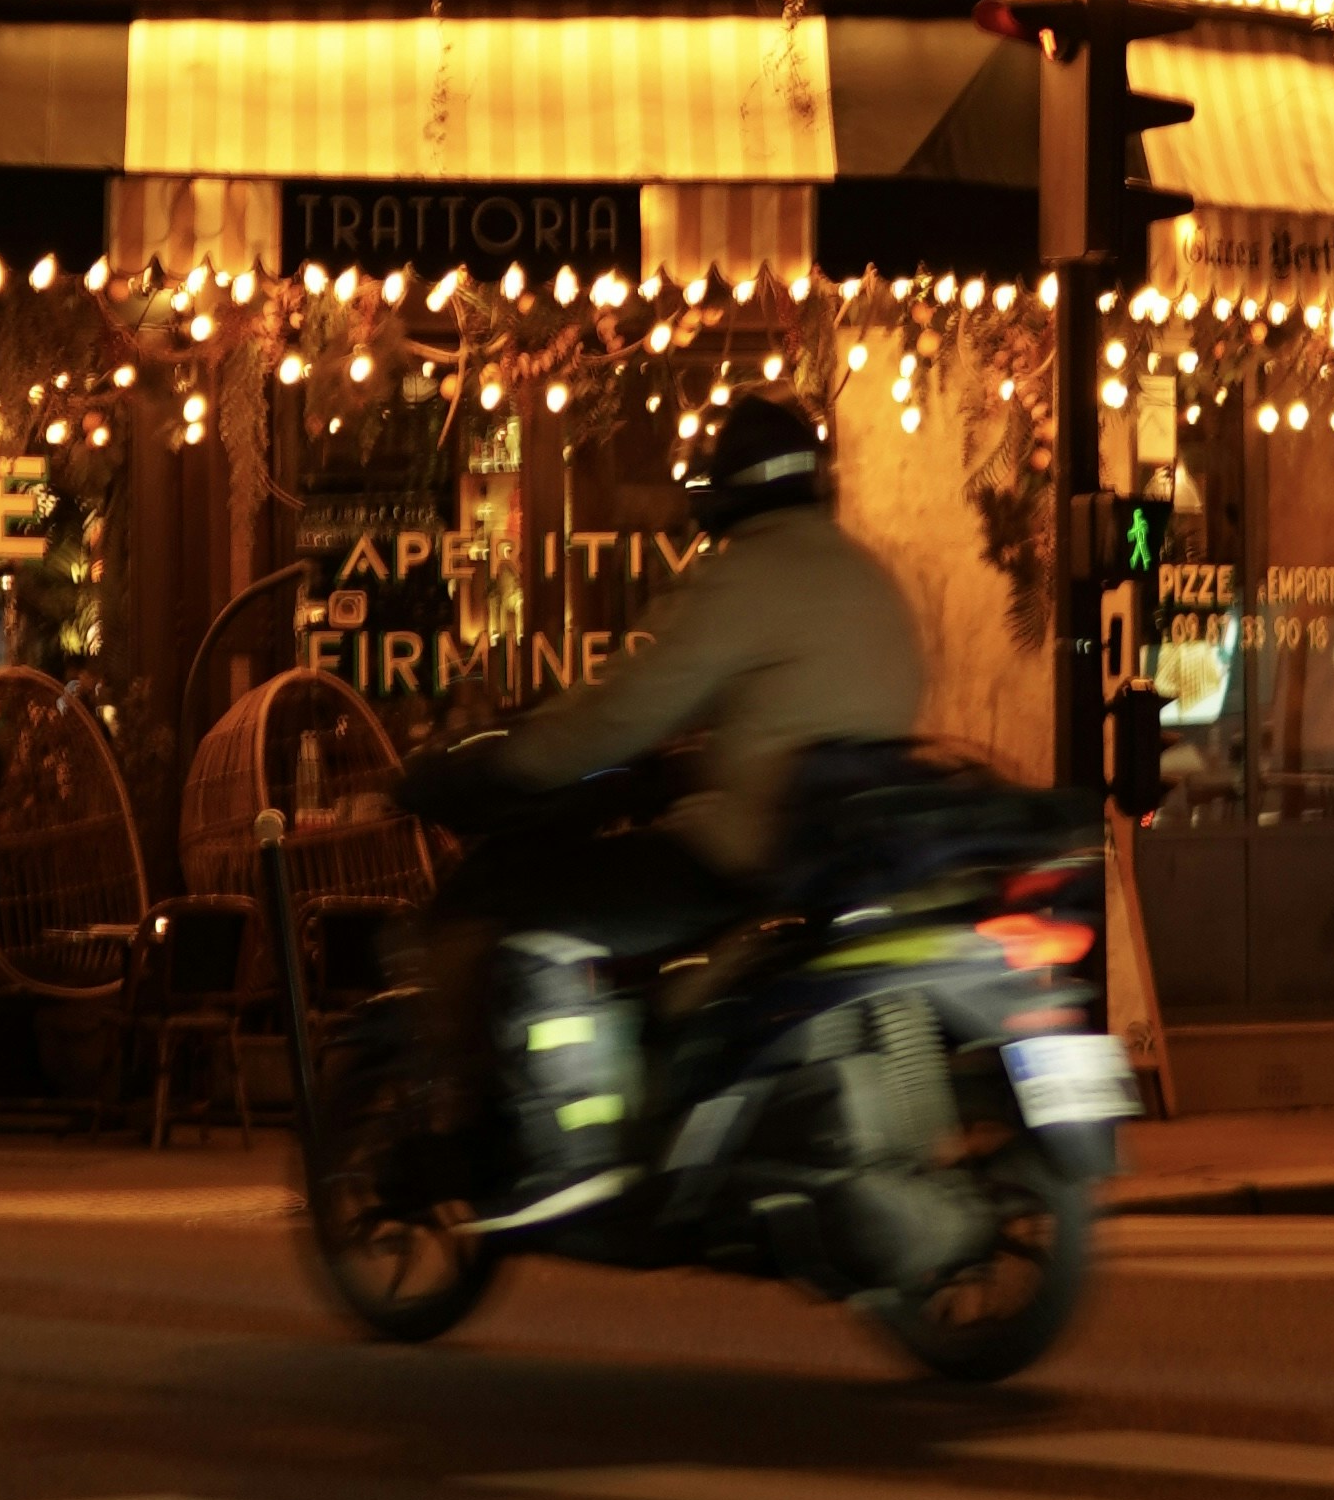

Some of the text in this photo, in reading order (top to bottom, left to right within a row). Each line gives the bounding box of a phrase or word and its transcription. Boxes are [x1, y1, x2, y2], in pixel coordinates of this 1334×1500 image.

[297, 194, 617, 256] TRATTORIA
[337, 531, 731, 580] APERITIV
[1158, 564, 1235, 605] PIZZE
